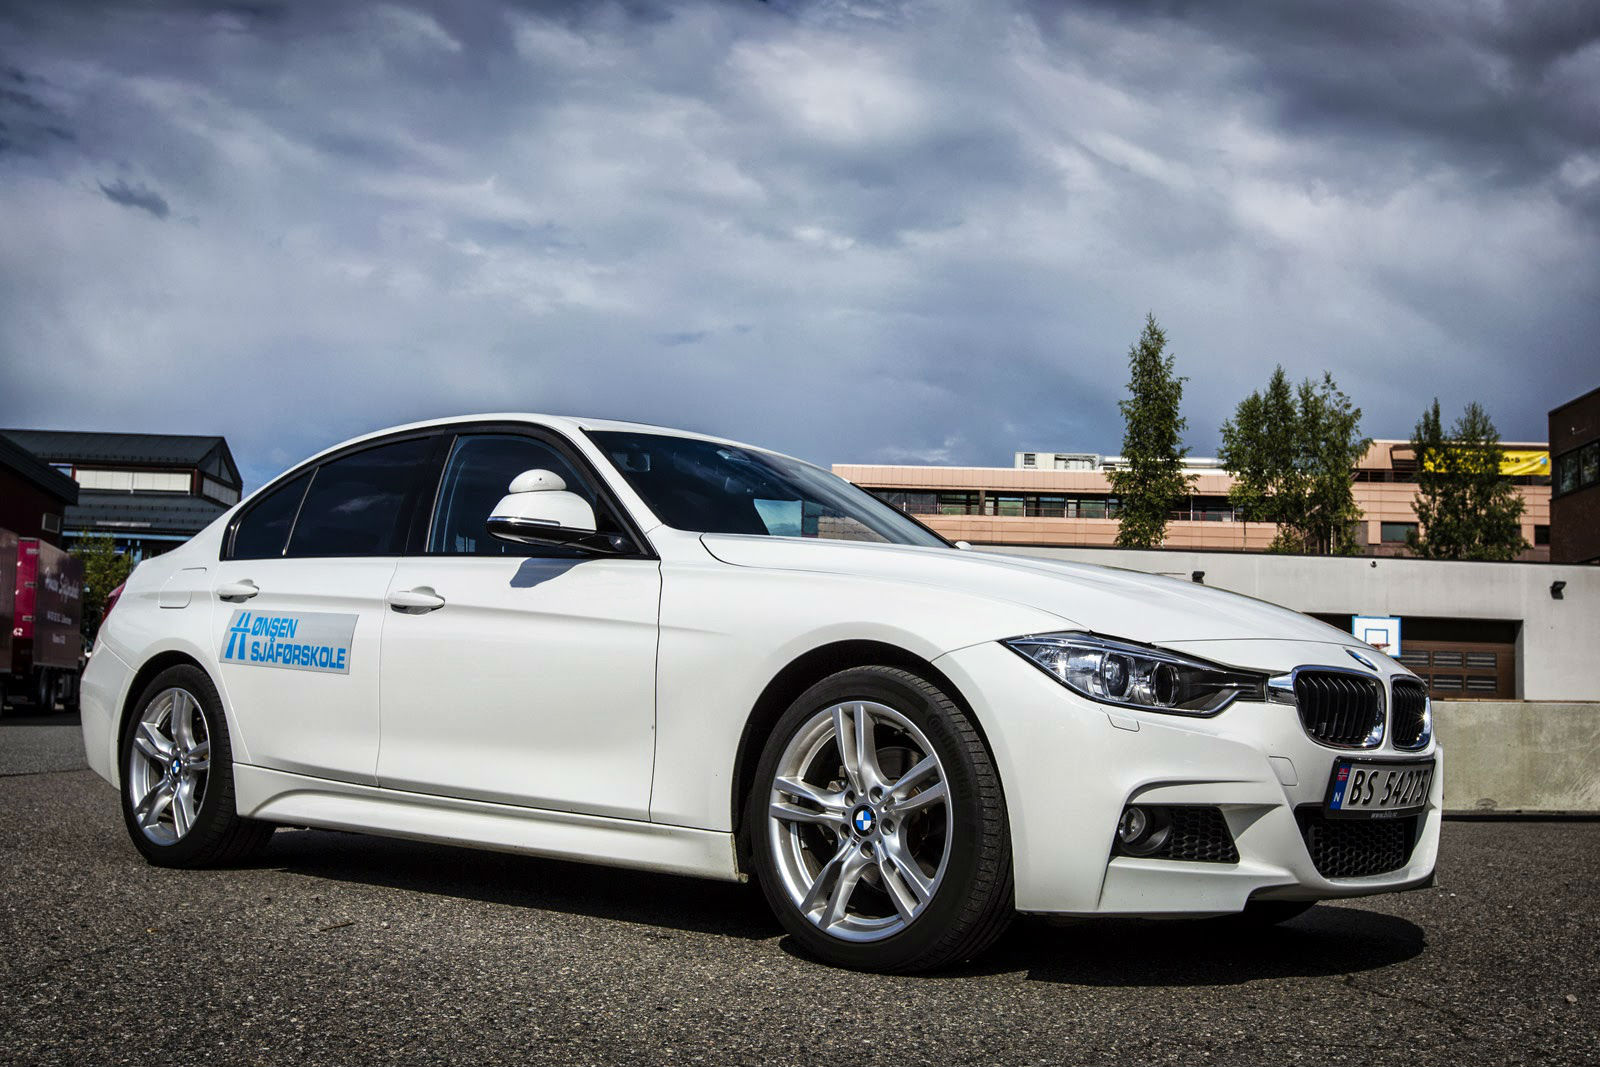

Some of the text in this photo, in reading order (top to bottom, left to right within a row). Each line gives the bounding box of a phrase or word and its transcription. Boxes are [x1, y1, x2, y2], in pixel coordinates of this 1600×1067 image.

[250, 638, 347, 669] SJÅFØRSKOLE
[1333, 792, 1342, 802] N
[1348, 769, 1428, 805] BS 54275
